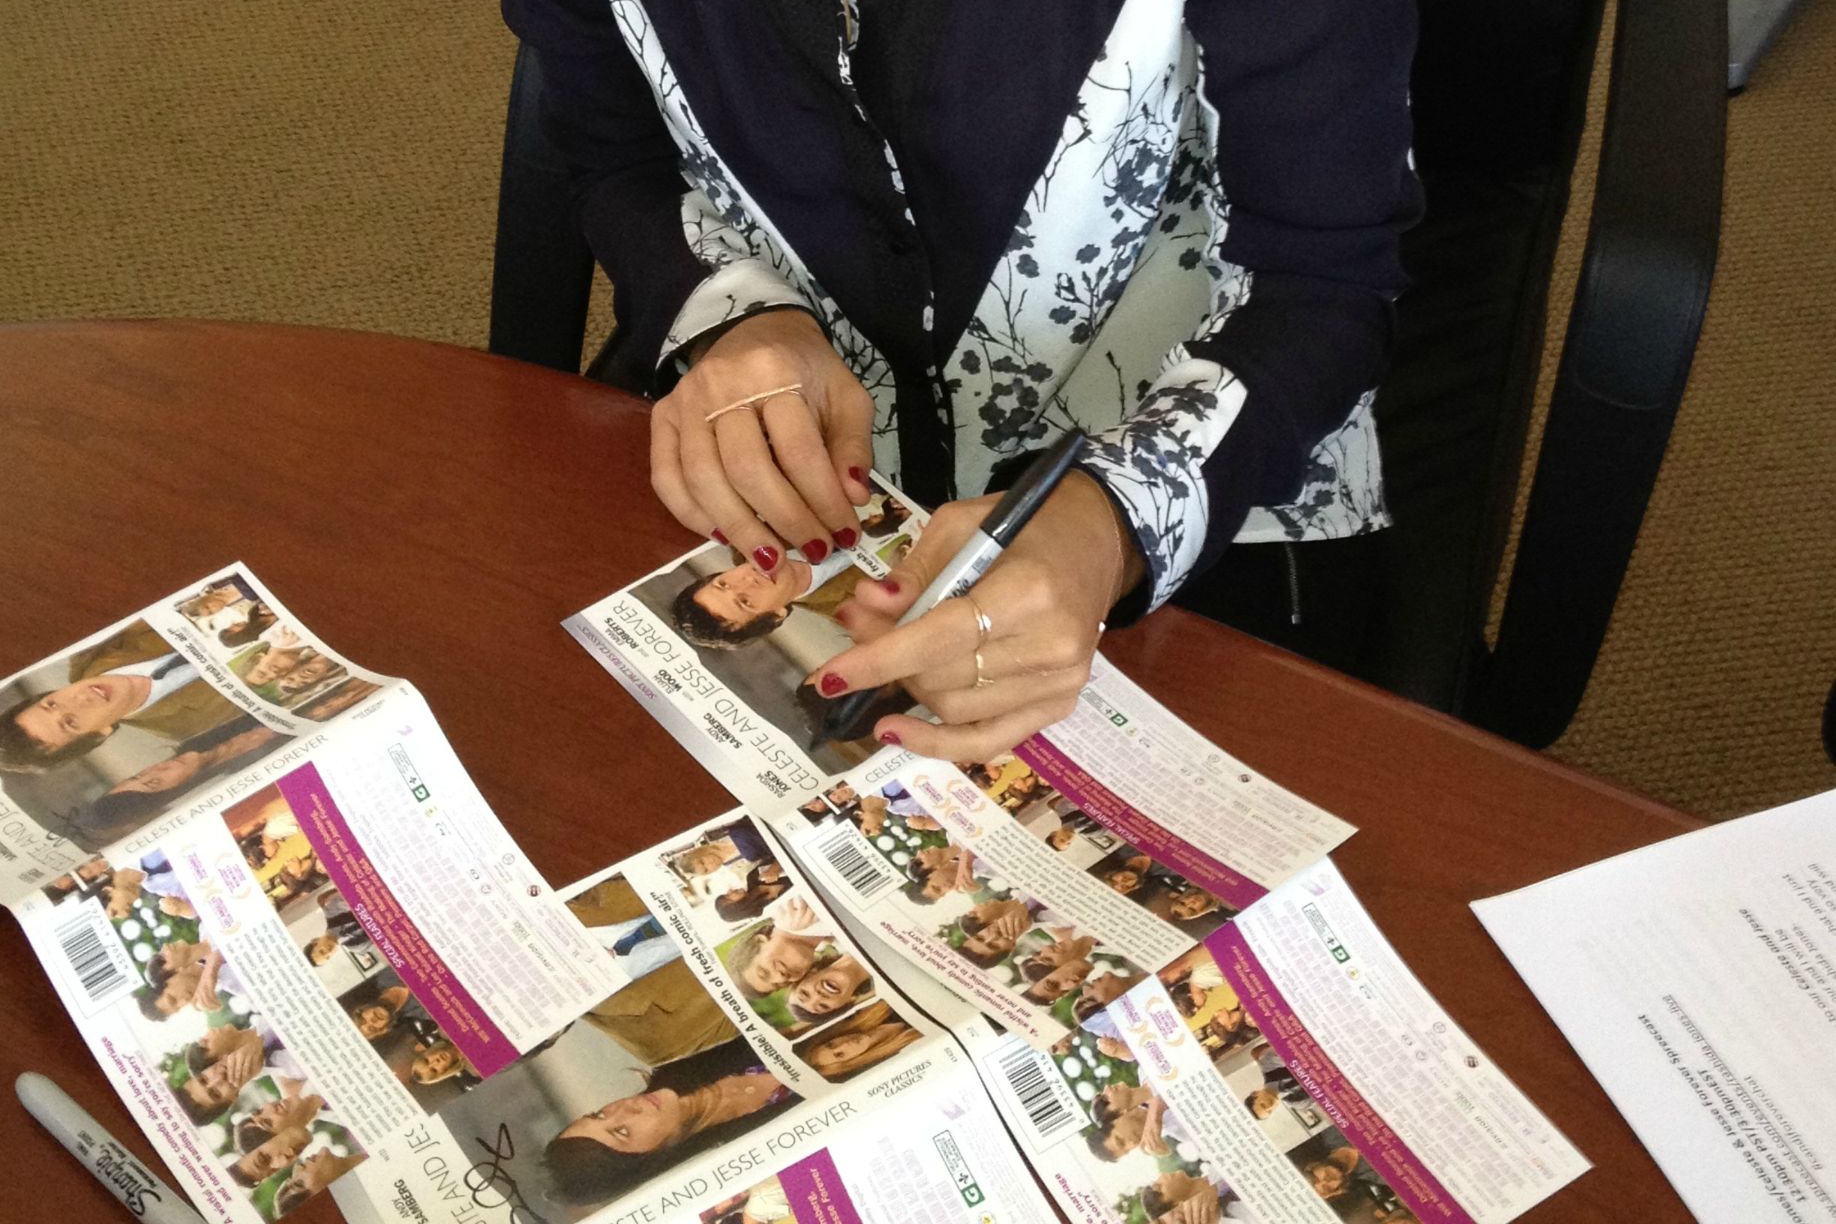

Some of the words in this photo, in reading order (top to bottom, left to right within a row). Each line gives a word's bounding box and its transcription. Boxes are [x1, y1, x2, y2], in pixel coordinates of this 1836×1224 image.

[853, 547, 879, 576] fresh
[602, 613, 639, 651] ROBERTS
[611, 597, 682, 664] FOREVER
[656, 666, 683, 693] WOOD
[674, 658, 723, 702] JESSE
[701, 709, 742, 751] SAMBERG
[712, 695, 759, 739] AND
[705, 724, 726, 745] ANDY
[751, 733, 819, 793] CELESTE
[862, 748, 916, 785] CELESTE
[123, 812, 188, 855] CELESTE
[187, 791, 225, 819] AND
[225, 771, 261, 798] JESSE
[263, 731, 330, 776] FOREVER
[763, 766, 791, 795] JONES
[1806, 860, 1826, 882] will
[1805, 875, 1828, 902] very
[1735, 905, 1765, 936] Jesse
[1800, 892, 1823, 919] and
[352, 901, 385, 941] FEATURES
[665, 912, 695, 948] comic
[877, 918, 911, 946] marriage
[1773, 926, 1789, 943] be
[377, 937, 405, 969] SPECIAL
[1756, 930, 1781, 956] and
[1783, 940, 1804, 961] will
[687, 945, 715, 976] fresh
[924, 955, 946, 973] about
[946, 957, 961, 970] say
[958, 967, 968, 977] to
[1774, 952, 1811, 992] Celeste
[1803, 964, 1826, 987] and
[708, 973, 725, 991] of
[945, 968, 974, 992] comedy
[967, 971, 996, 996] wanting
[718, 987, 750, 1025] breath
[972, 987, 1005, 1014] romantic
[995, 991, 1018, 1010] never
[1015, 1006, 1032, 1020] and
[1808, 990, 1827, 1010] our
[744, 1022, 757, 1034] A
[1822, 1008, 1836, 1024] to
[1634, 1011, 1682, 1066] Spreecast
[96, 1034, 131, 1075] marriage
[866, 1079, 891, 1098] SONY
[888, 1056, 933, 1086] PICTURES
[882, 1071, 925, 1099] CLASSICS
[1288, 1057, 1324, 1099] FEATURES
[1673, 1062, 1714, 1110] Forever
[136, 1096, 159, 1122] about
[158, 1103, 175, 1121] say
[1319, 1095, 1349, 1129] SPECIAL
[1709, 1109, 1737, 1139] Jesse
[153, 1118, 183, 1154] comedy
[168, 1120, 180, 1132] to
[175, 1129, 205, 1164] wanting
[655, 1175, 712, 1214] AND
[709, 1146, 769, 1189] JESSE
[766, 1098, 858, 1157] FOREVER
[1729, 1135, 1745, 1150] &
[90, 1146, 160, 1216] Sharpie
[176, 1152, 207, 1190] romantic
[198, 1160, 221, 1187] never
[420, 1152, 464, 1204] AND
[803, 1165, 835, 1205] Forever
[1738, 1146, 1805, 1224] ones/Celeste
[1762, 1150, 1808, 1205] 12:30pm
[200, 1187, 227, 1218] wistful
[214, 1185, 232, 1204] and
[392, 1177, 428, 1224] SAMBERG
[1050, 1170, 1089, 1213] marriage
[391, 1195, 410, 1220] ANDY
